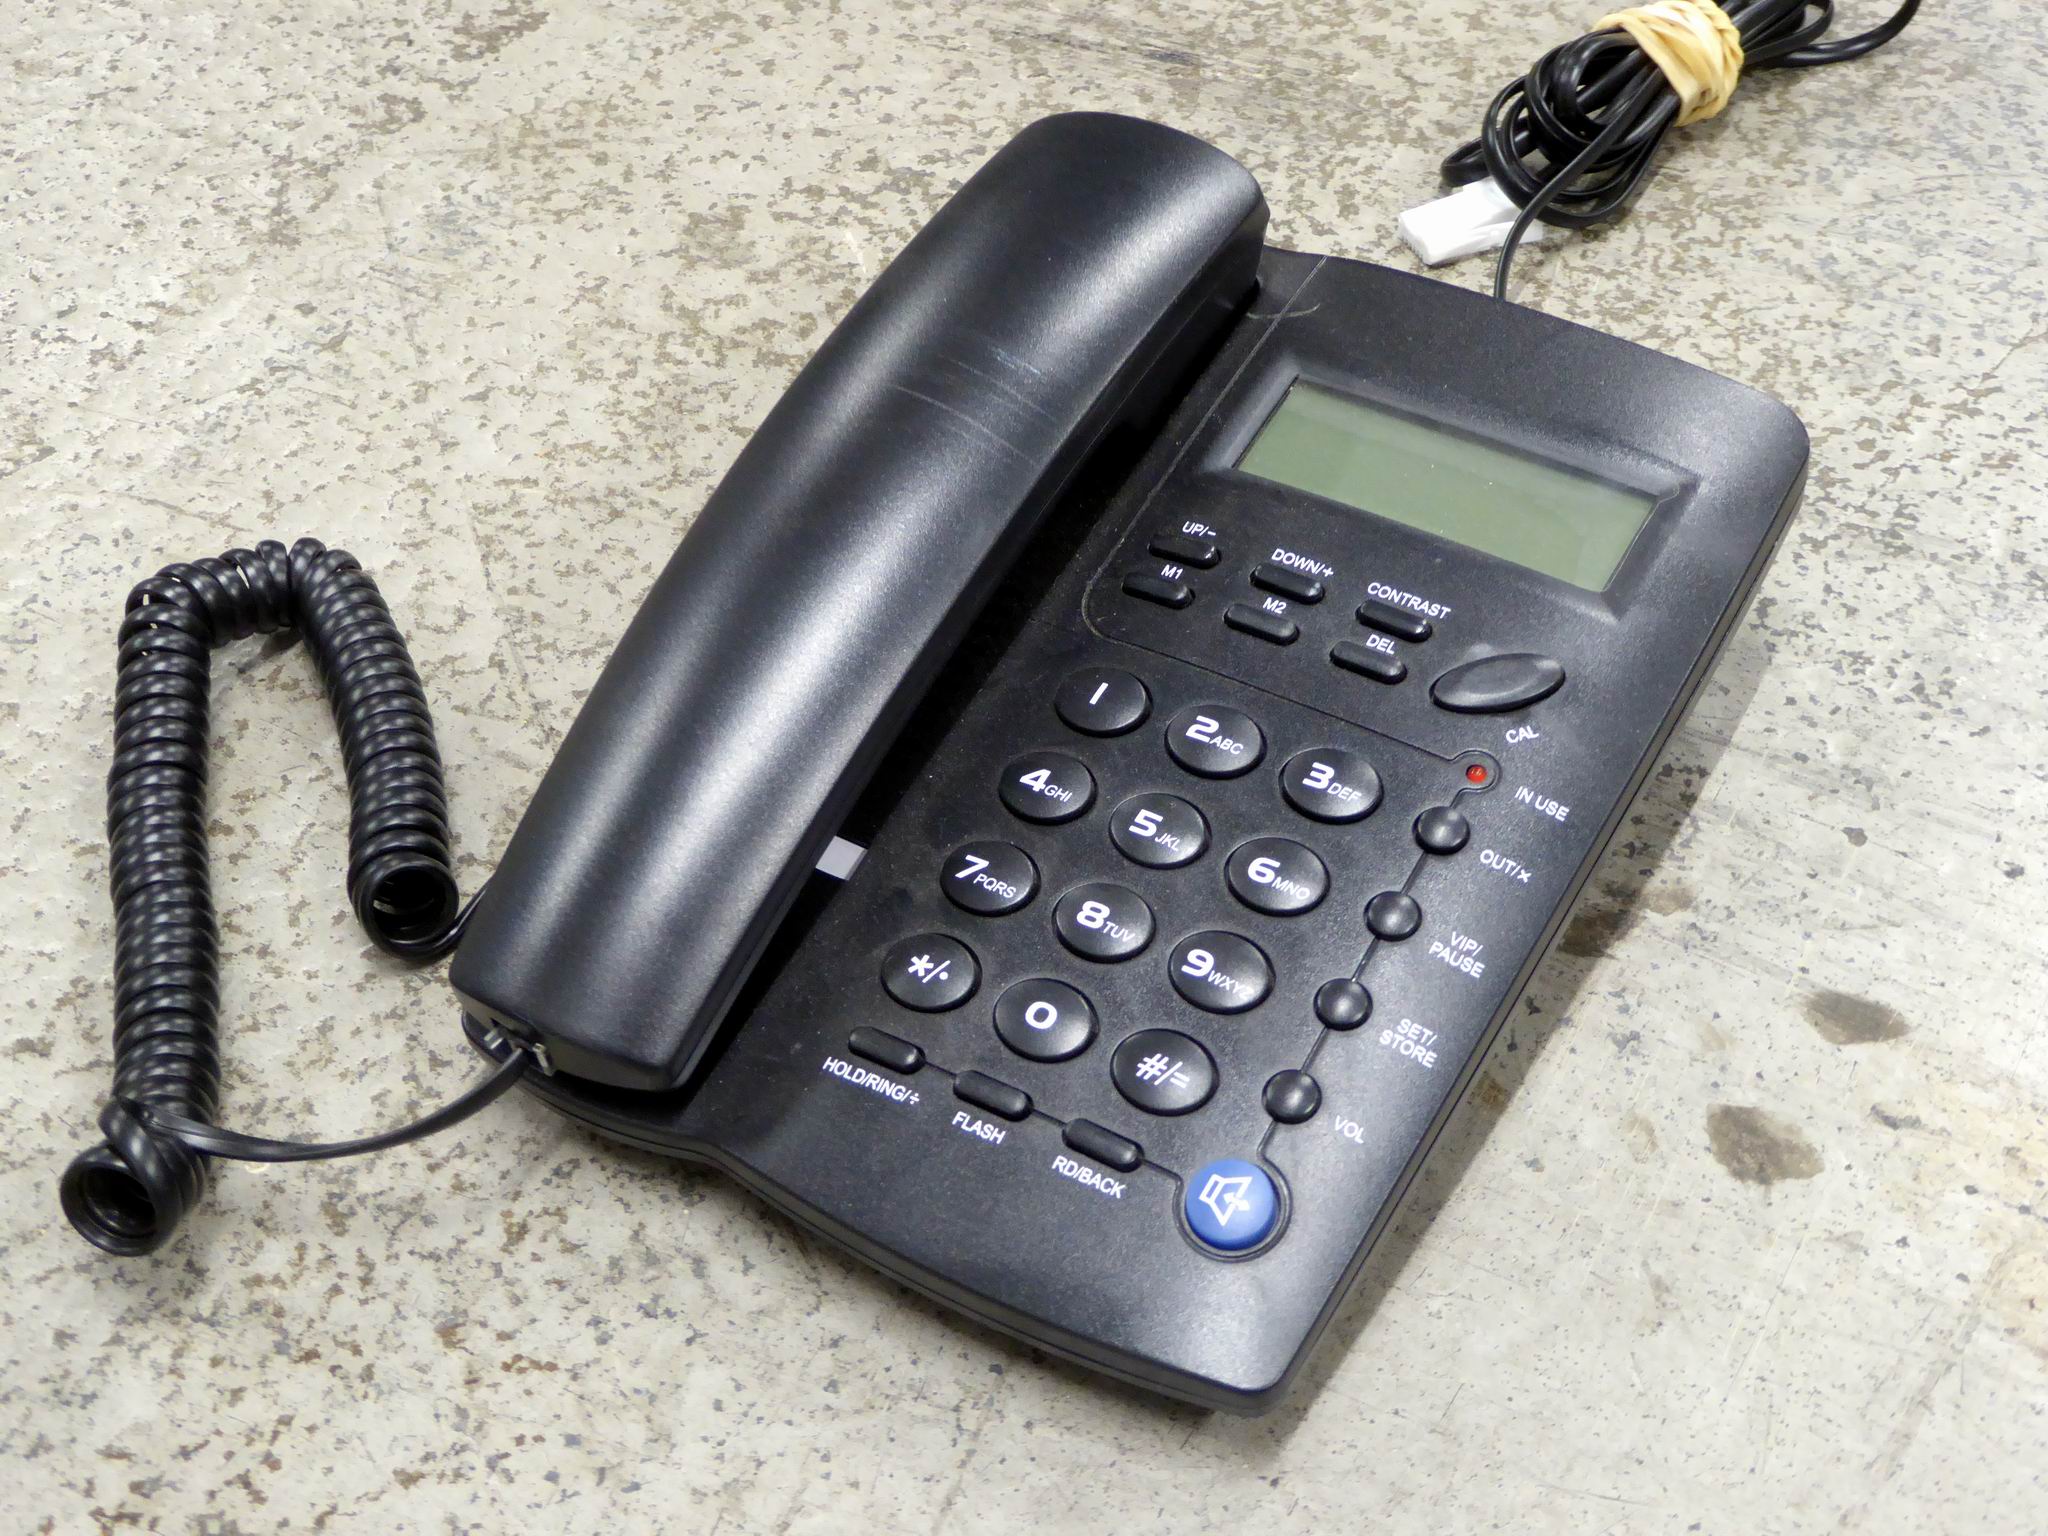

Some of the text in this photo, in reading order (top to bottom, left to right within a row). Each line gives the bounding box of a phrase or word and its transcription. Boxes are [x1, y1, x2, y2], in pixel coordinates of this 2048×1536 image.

[1161, 565, 1182, 579] M1
[1272, 548, 1334, 578] DOWN/+
[1263, 597, 1287, 613] M2
[1368, 582, 1451, 619] CONTRAST
[1366, 634, 1395, 654] DEL
[1505, 726, 1539, 743] CAL
[1515, 786, 1569, 821] IN USE
[1451, 931, 1484, 954] VIP/
[1429, 941, 1485, 978] PAUSE
[1397, 1018, 1437, 1045] SET/
[1379, 1030, 1437, 1068] STORE
[1137, 1053, 1190, 1089] #/=
[952, 1111, 1005, 1143] FLASH
[1334, 1115, 1364, 1143] VOL
[1052, 1156, 1126, 1199] RD/BACK
